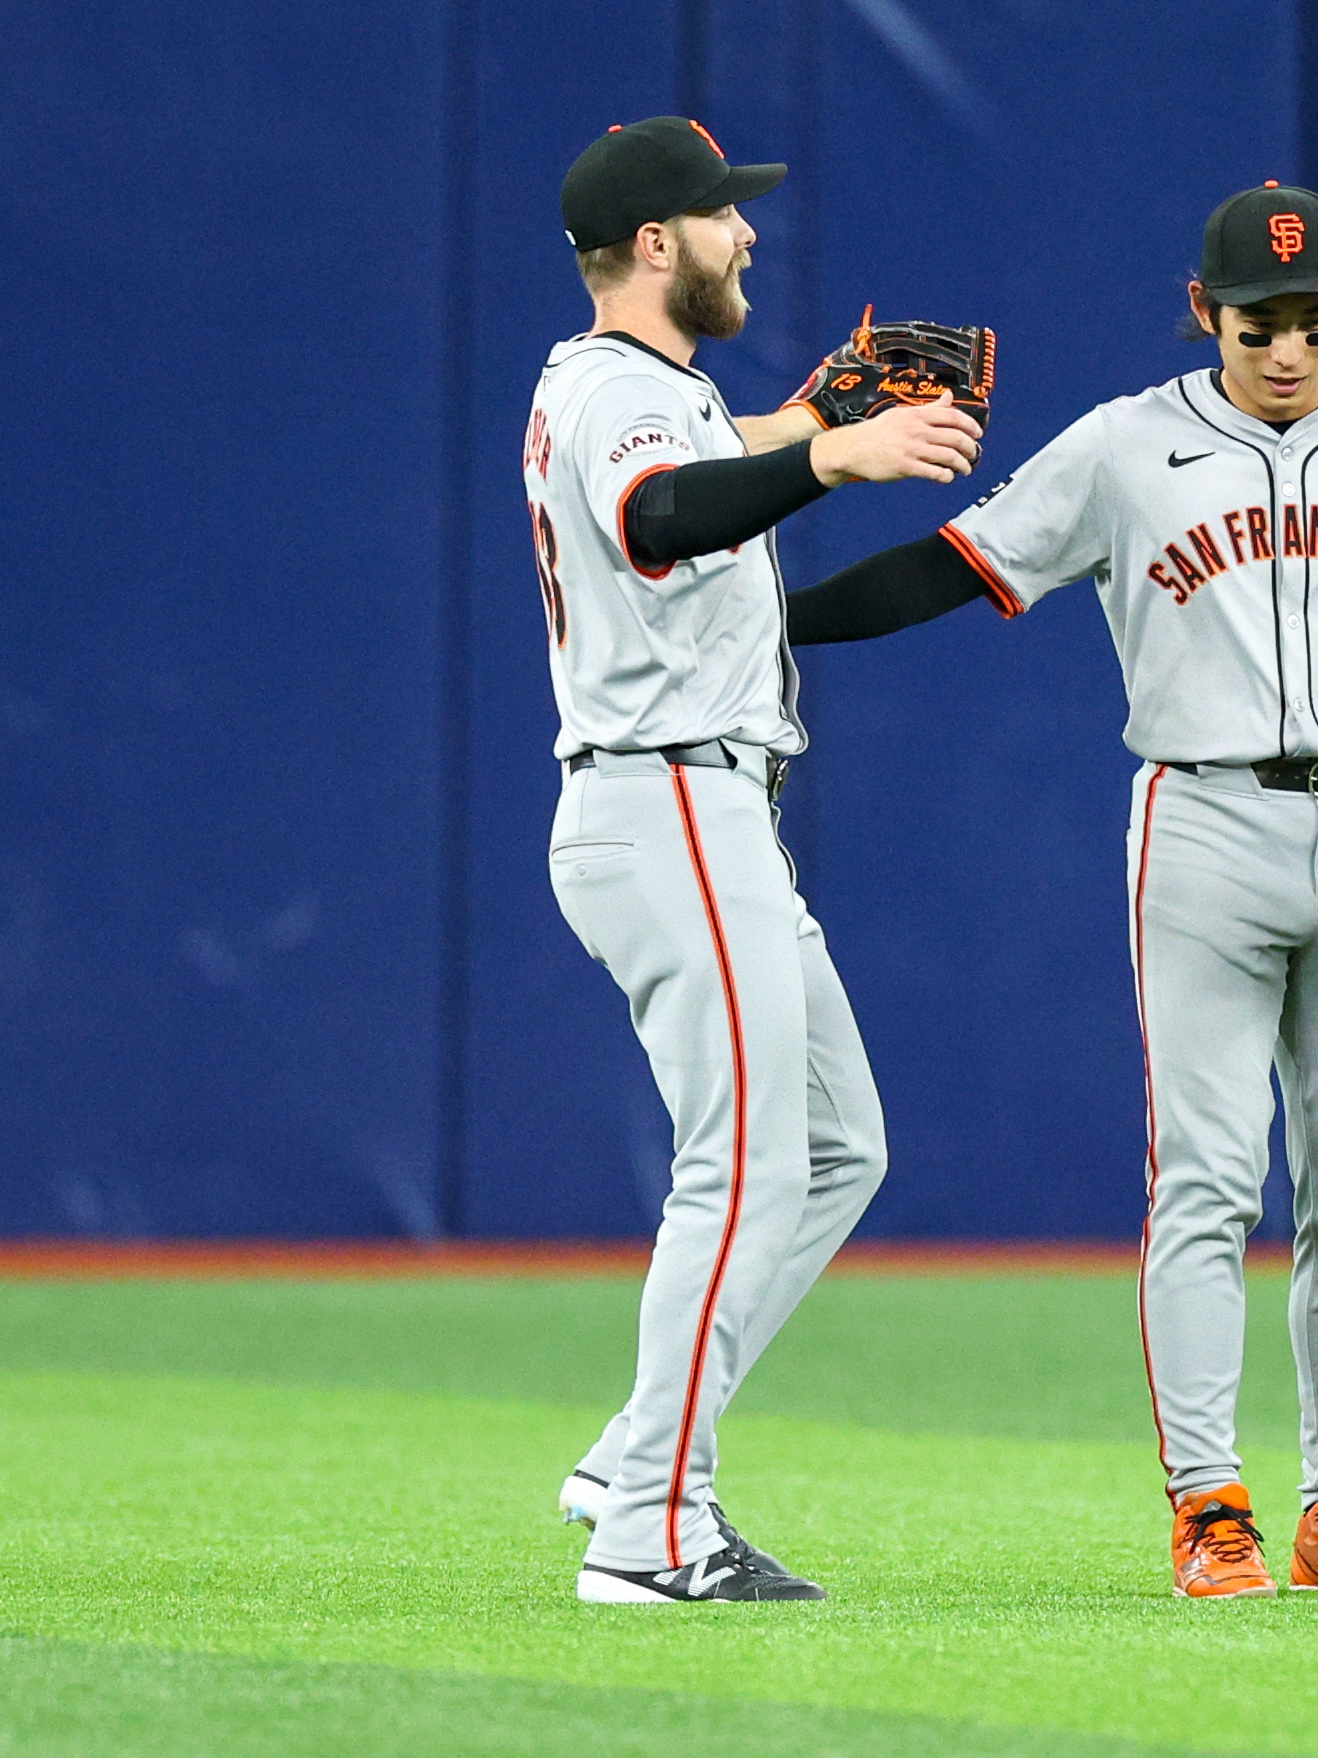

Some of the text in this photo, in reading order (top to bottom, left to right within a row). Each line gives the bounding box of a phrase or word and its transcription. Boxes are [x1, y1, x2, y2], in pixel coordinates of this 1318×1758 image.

[830, 372, 863, 392] 13
[876, 376, 948, 396] Austin Slate
[609, 433, 690, 463] GIANTS
[1148, 522, 1230, 606] SAN
